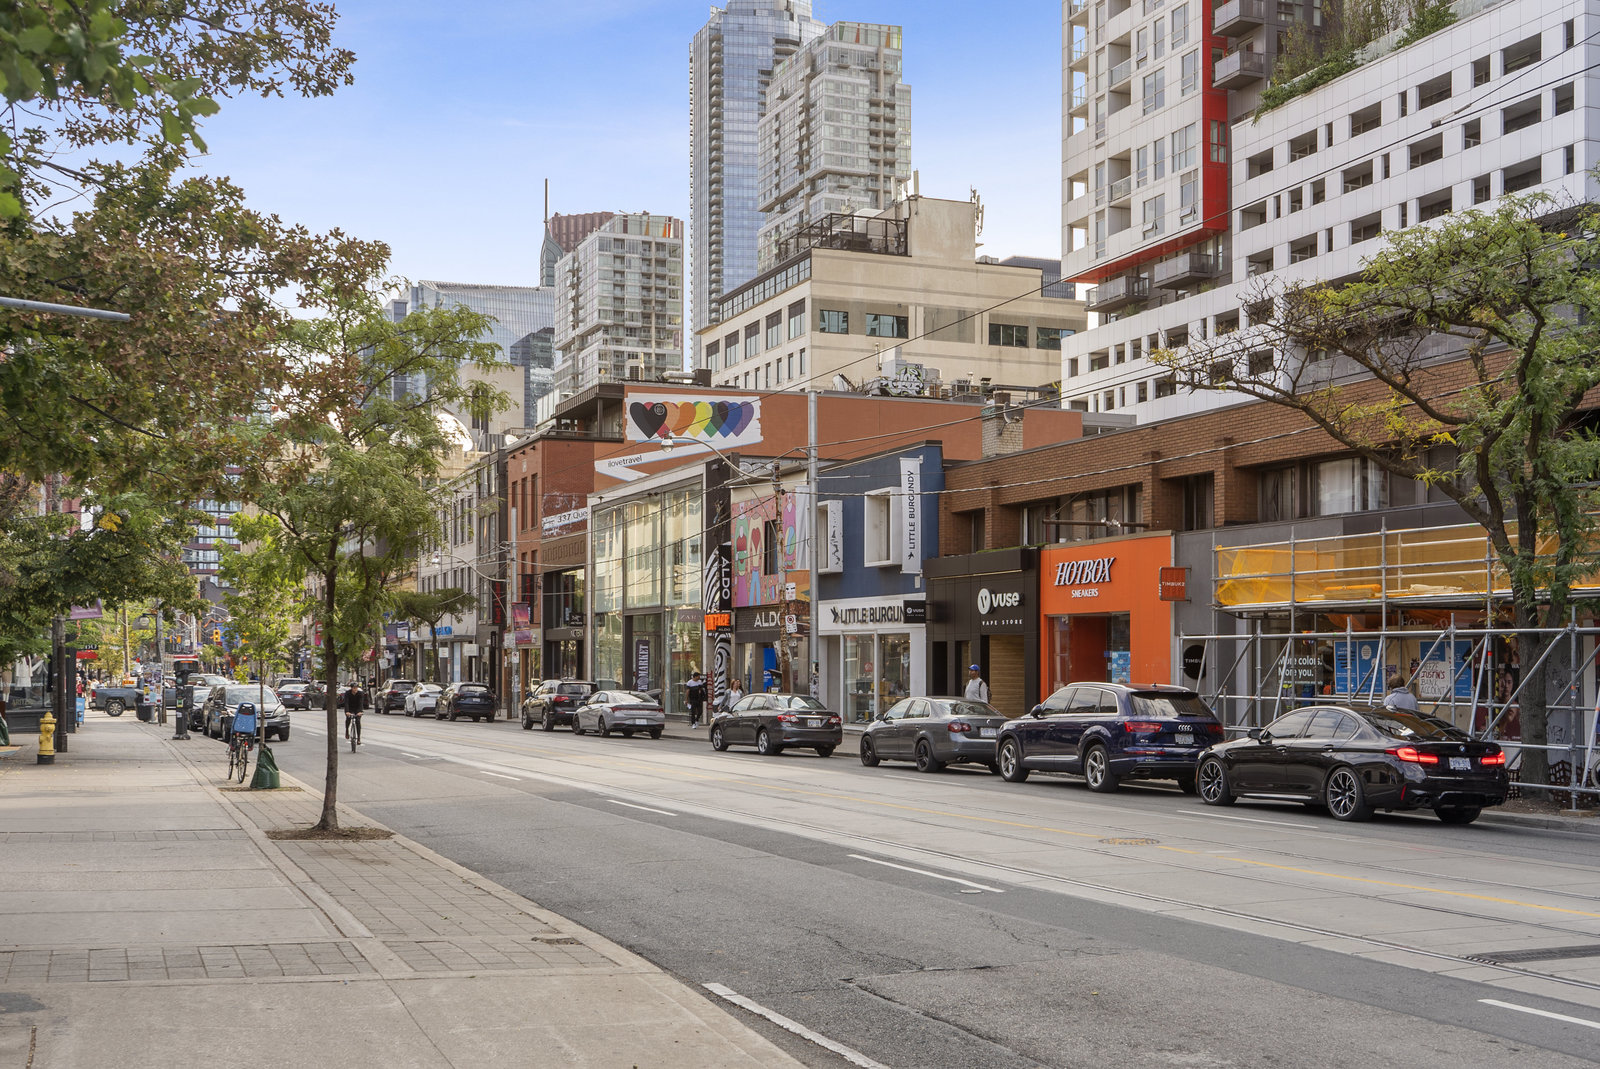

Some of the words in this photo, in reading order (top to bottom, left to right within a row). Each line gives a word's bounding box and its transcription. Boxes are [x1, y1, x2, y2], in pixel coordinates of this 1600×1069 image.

[607, 455, 643, 468] ilovetravel
[907, 470, 915, 518] BURGUNDY
[557, 514, 571, 523] 337
[908, 522, 916, 549] LITTLE
[721, 556, 731, 600] ALDO
[1053, 557, 1116, 586] HOTBOX
[1071, 588, 1099, 598] SNEAKERS
[841, 608, 868, 624] LITTLE
[638, 644, 649, 677] MARKET
[1298, 669, 1314, 679] you.
